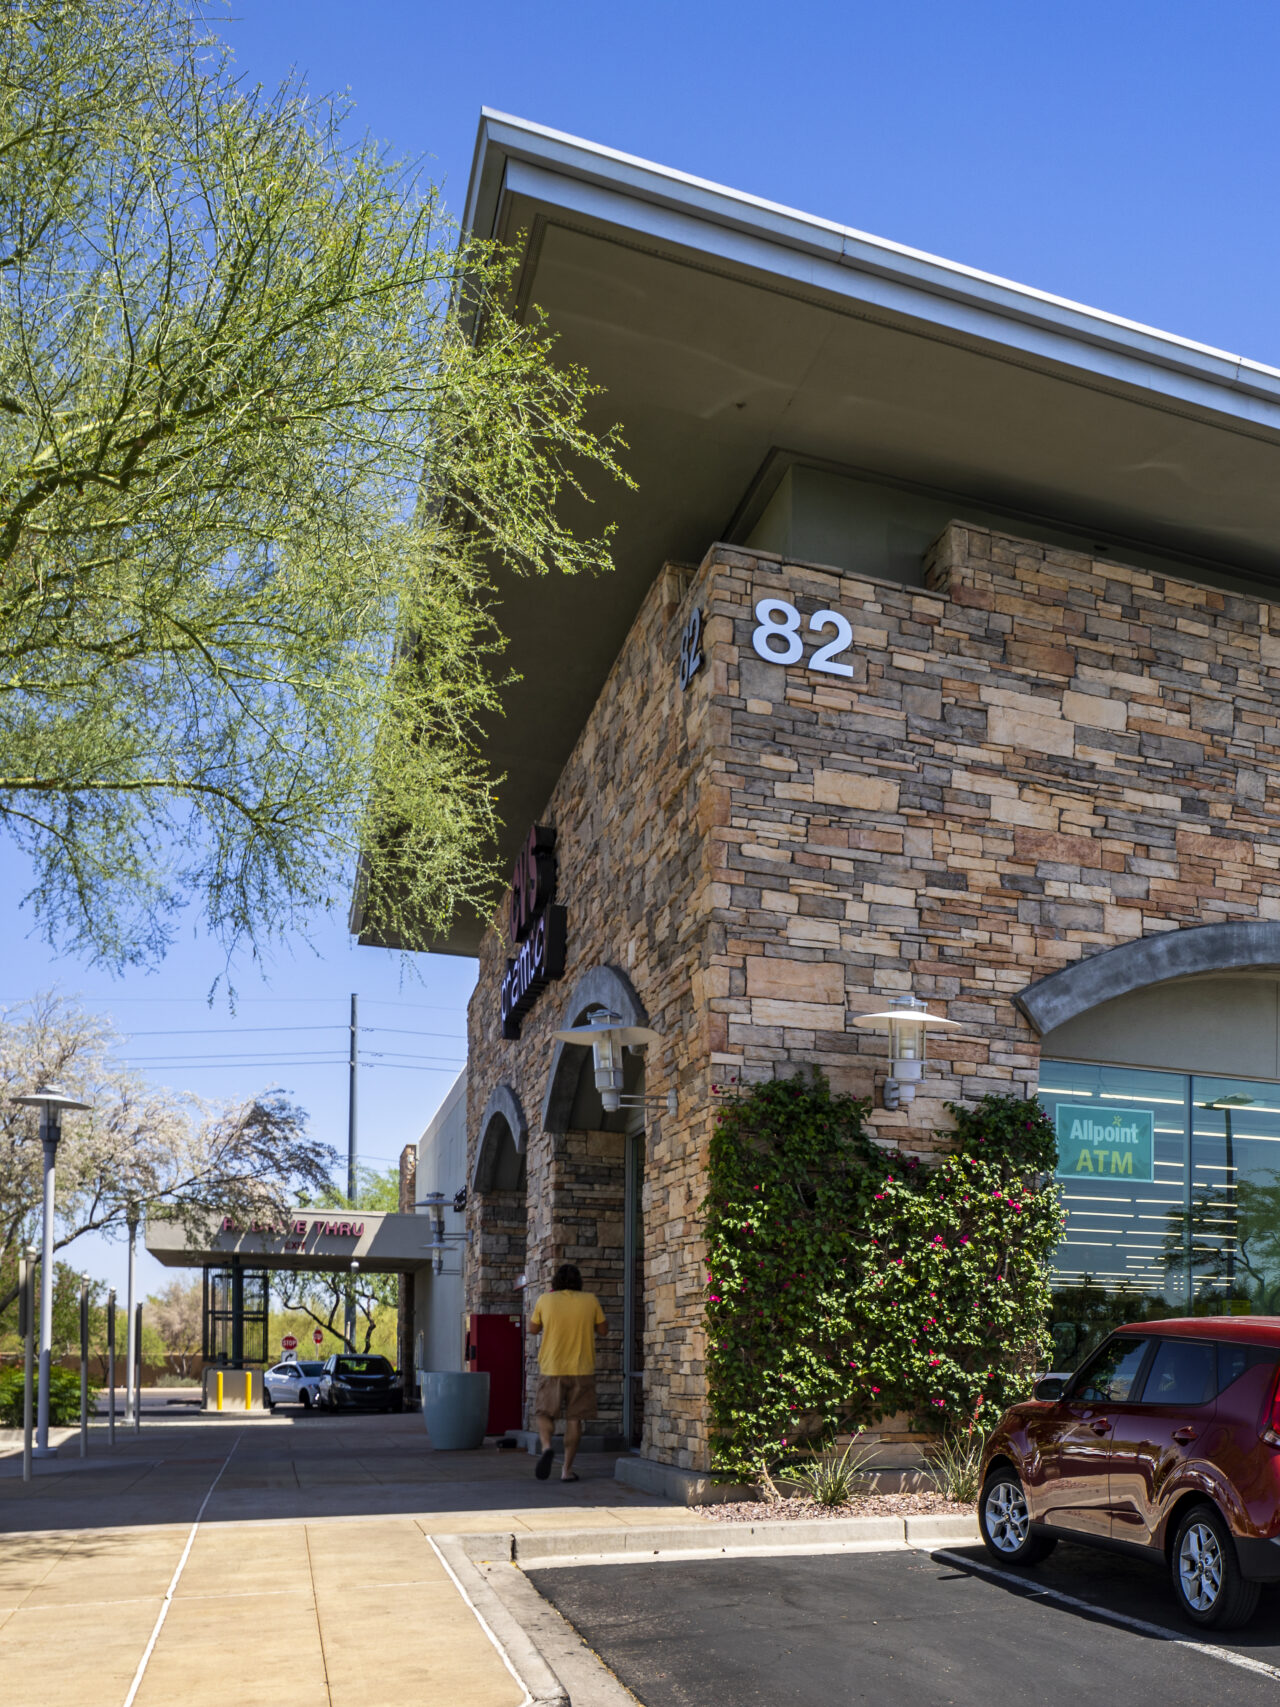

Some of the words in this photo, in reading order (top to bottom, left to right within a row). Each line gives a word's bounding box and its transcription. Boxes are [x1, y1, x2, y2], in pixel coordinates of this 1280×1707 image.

[680, 607, 701, 692] 82
[752, 598, 854, 678] 82
[1070, 1117, 1139, 1146] Allpoint
[1076, 1149, 1133, 1174] ATM
[314, 1220, 365, 1237] THRU
[284, 1240, 307, 1251] EXIT
